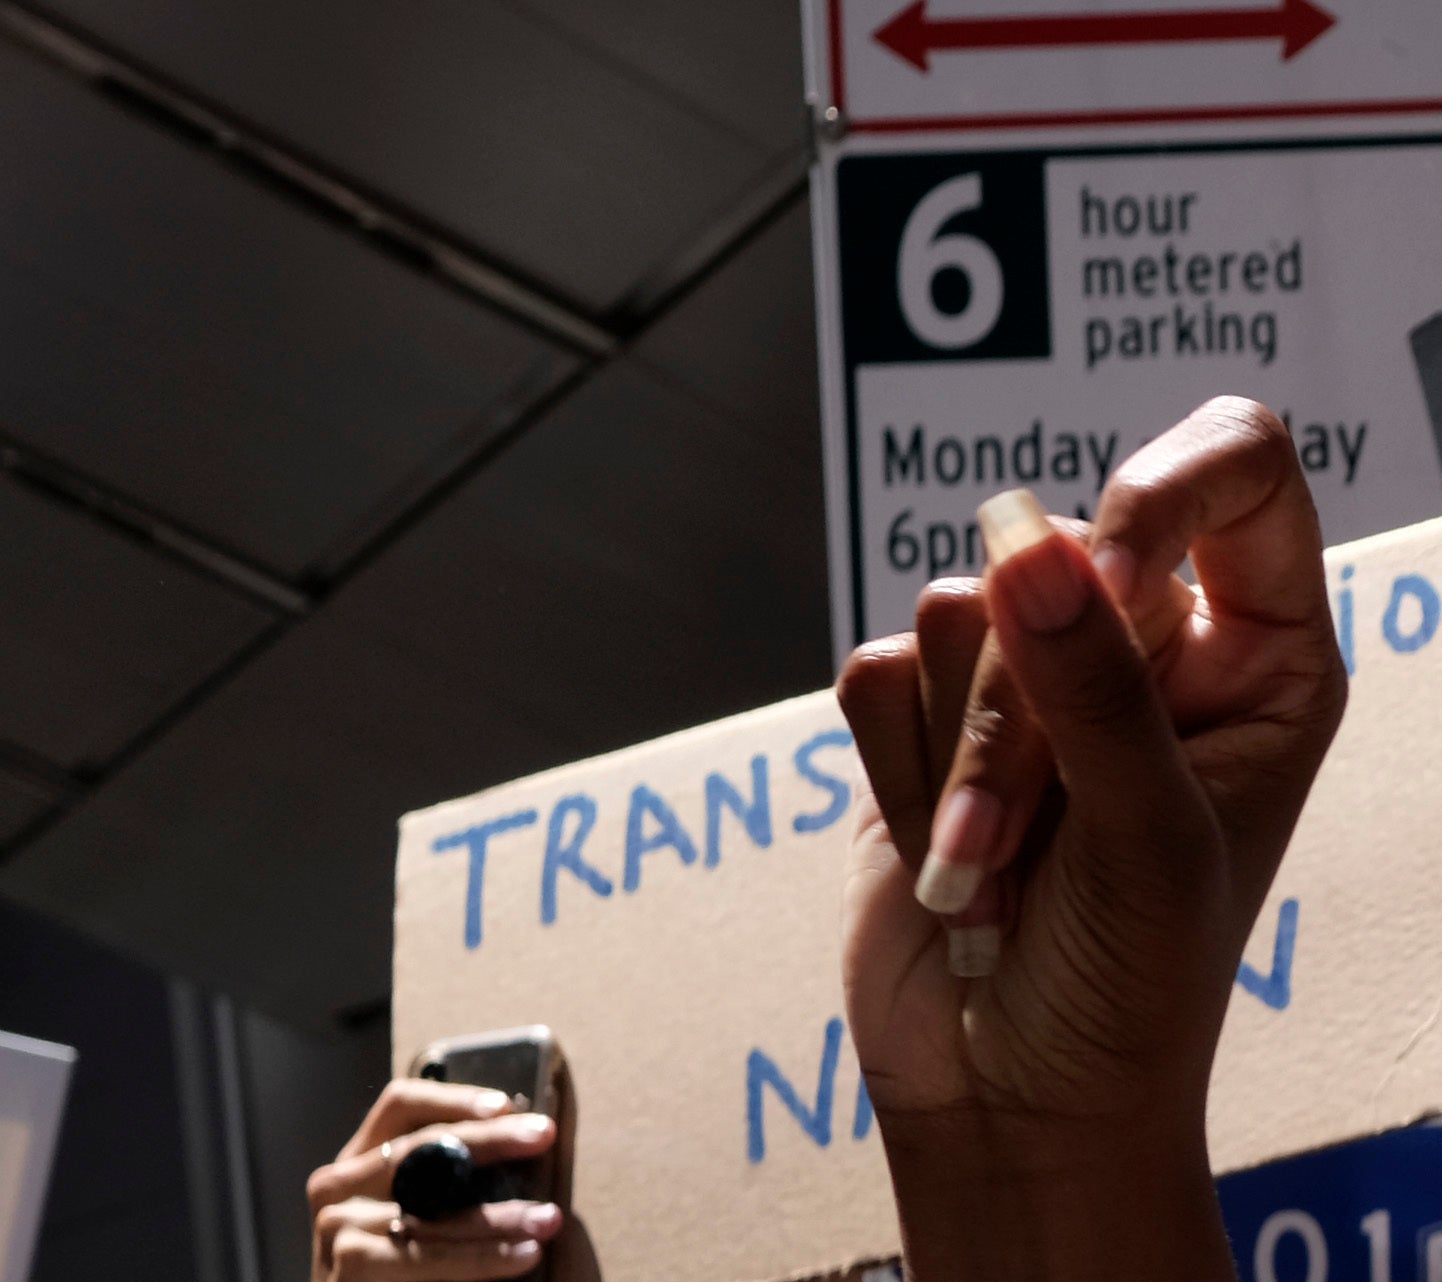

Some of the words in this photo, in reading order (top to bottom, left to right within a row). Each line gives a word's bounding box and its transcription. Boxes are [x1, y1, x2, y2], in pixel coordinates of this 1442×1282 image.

[1080, 186, 1198, 239] hour
[896, 172, 1004, 350] 6
[1081, 240, 1304, 297] metered
[1085, 311, 1279, 370] parking
[882, 420, 1118, 490] Monday
[886, 508, 992, 580] 6p
